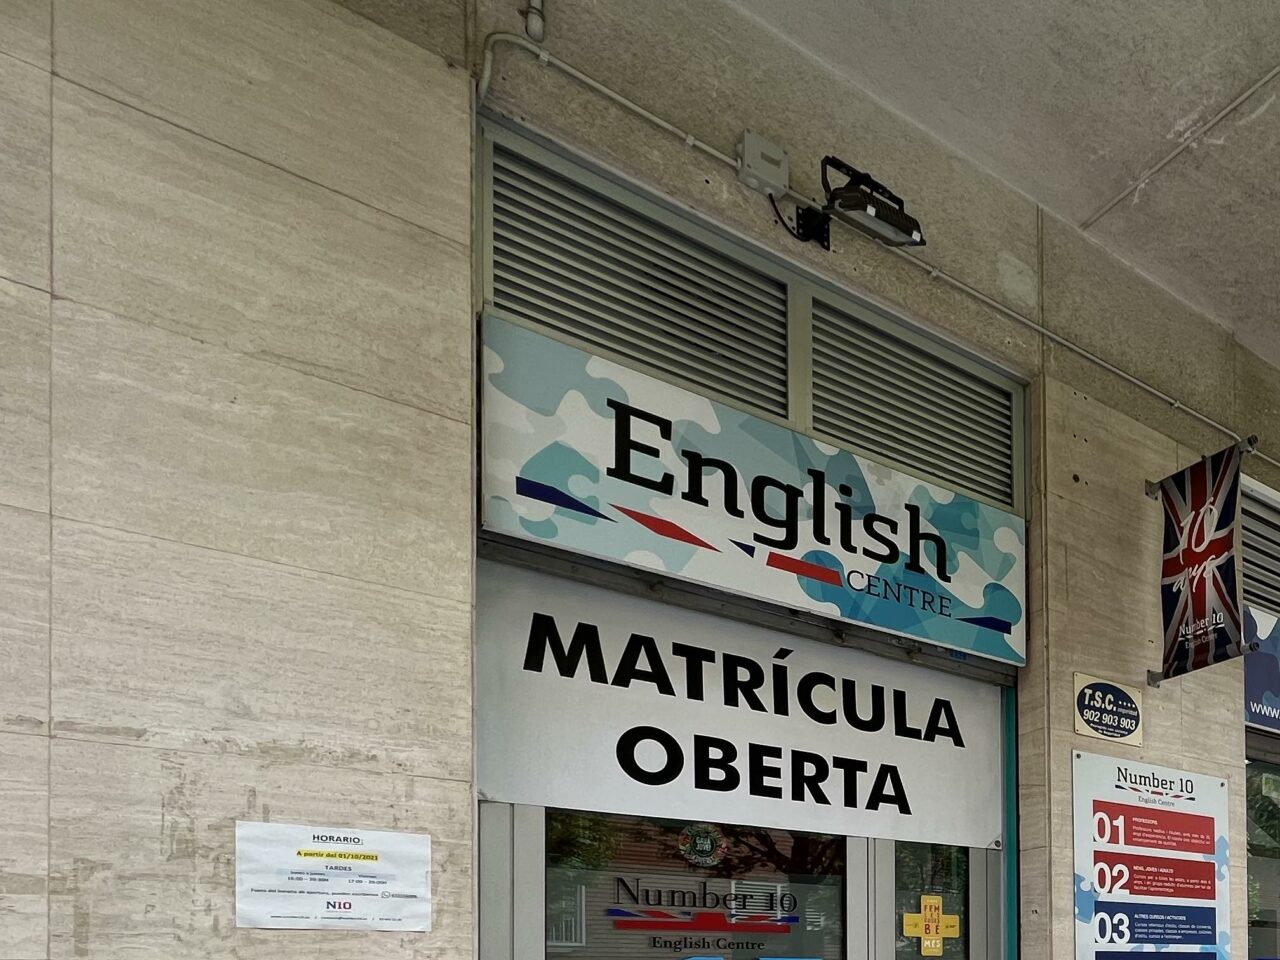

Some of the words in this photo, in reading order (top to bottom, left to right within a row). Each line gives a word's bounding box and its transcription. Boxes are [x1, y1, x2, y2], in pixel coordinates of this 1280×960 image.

[606, 398, 951, 583] English
[1180, 496, 1218, 566] 10
[846, 569, 953, 618] CENTRE
[1212, 612, 1223, 624] 10
[522, 611, 966, 748] MATRÍCULA
[1083, 709, 1100, 722] 902
[1102, 713, 1118, 726] 903
[1120, 717, 1136, 731] 903
[615, 725, 912, 815] OBERTA
[1116, 766, 1174, 791] Number
[1180, 778, 1194, 794] 10
[1138, 795, 1157, 806] English
[1158, 798, 1175, 807] Centre
[1092, 811, 1126, 846] 01
[615, 877, 754, 909] Number
[767, 892, 797, 912] 10
[1093, 862, 1130, 894] 02
[652, 936, 710, 952] English
[716, 937, 765, 951] Centre
[1094, 912, 1131, 944] 03
